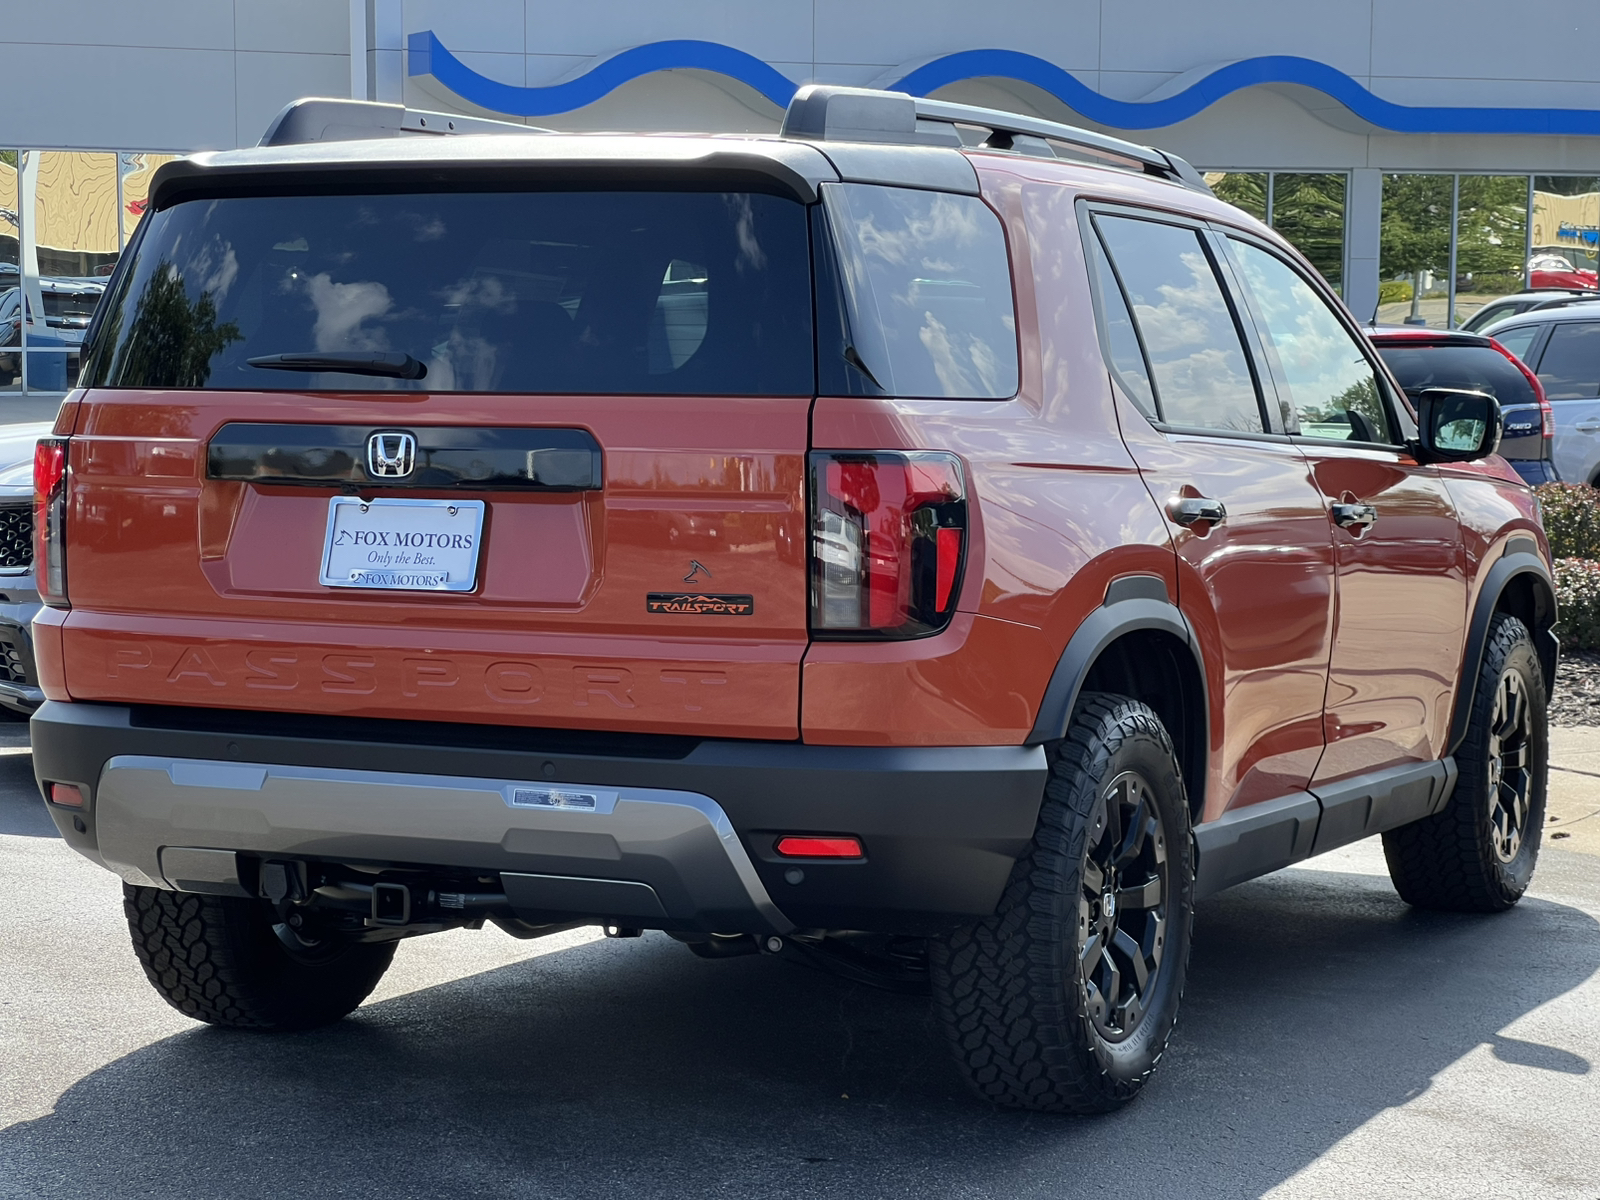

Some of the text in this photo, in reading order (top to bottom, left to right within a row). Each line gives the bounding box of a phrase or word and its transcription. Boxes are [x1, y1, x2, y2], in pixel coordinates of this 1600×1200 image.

[353, 530, 473, 549] FOX MOTORS
[367, 550, 436, 567] Only the Best.
[365, 573, 440, 587] FOX MOTORS
[649, 602, 750, 615] TRAILSPORT
[105, 642, 729, 712] PASSPORT
